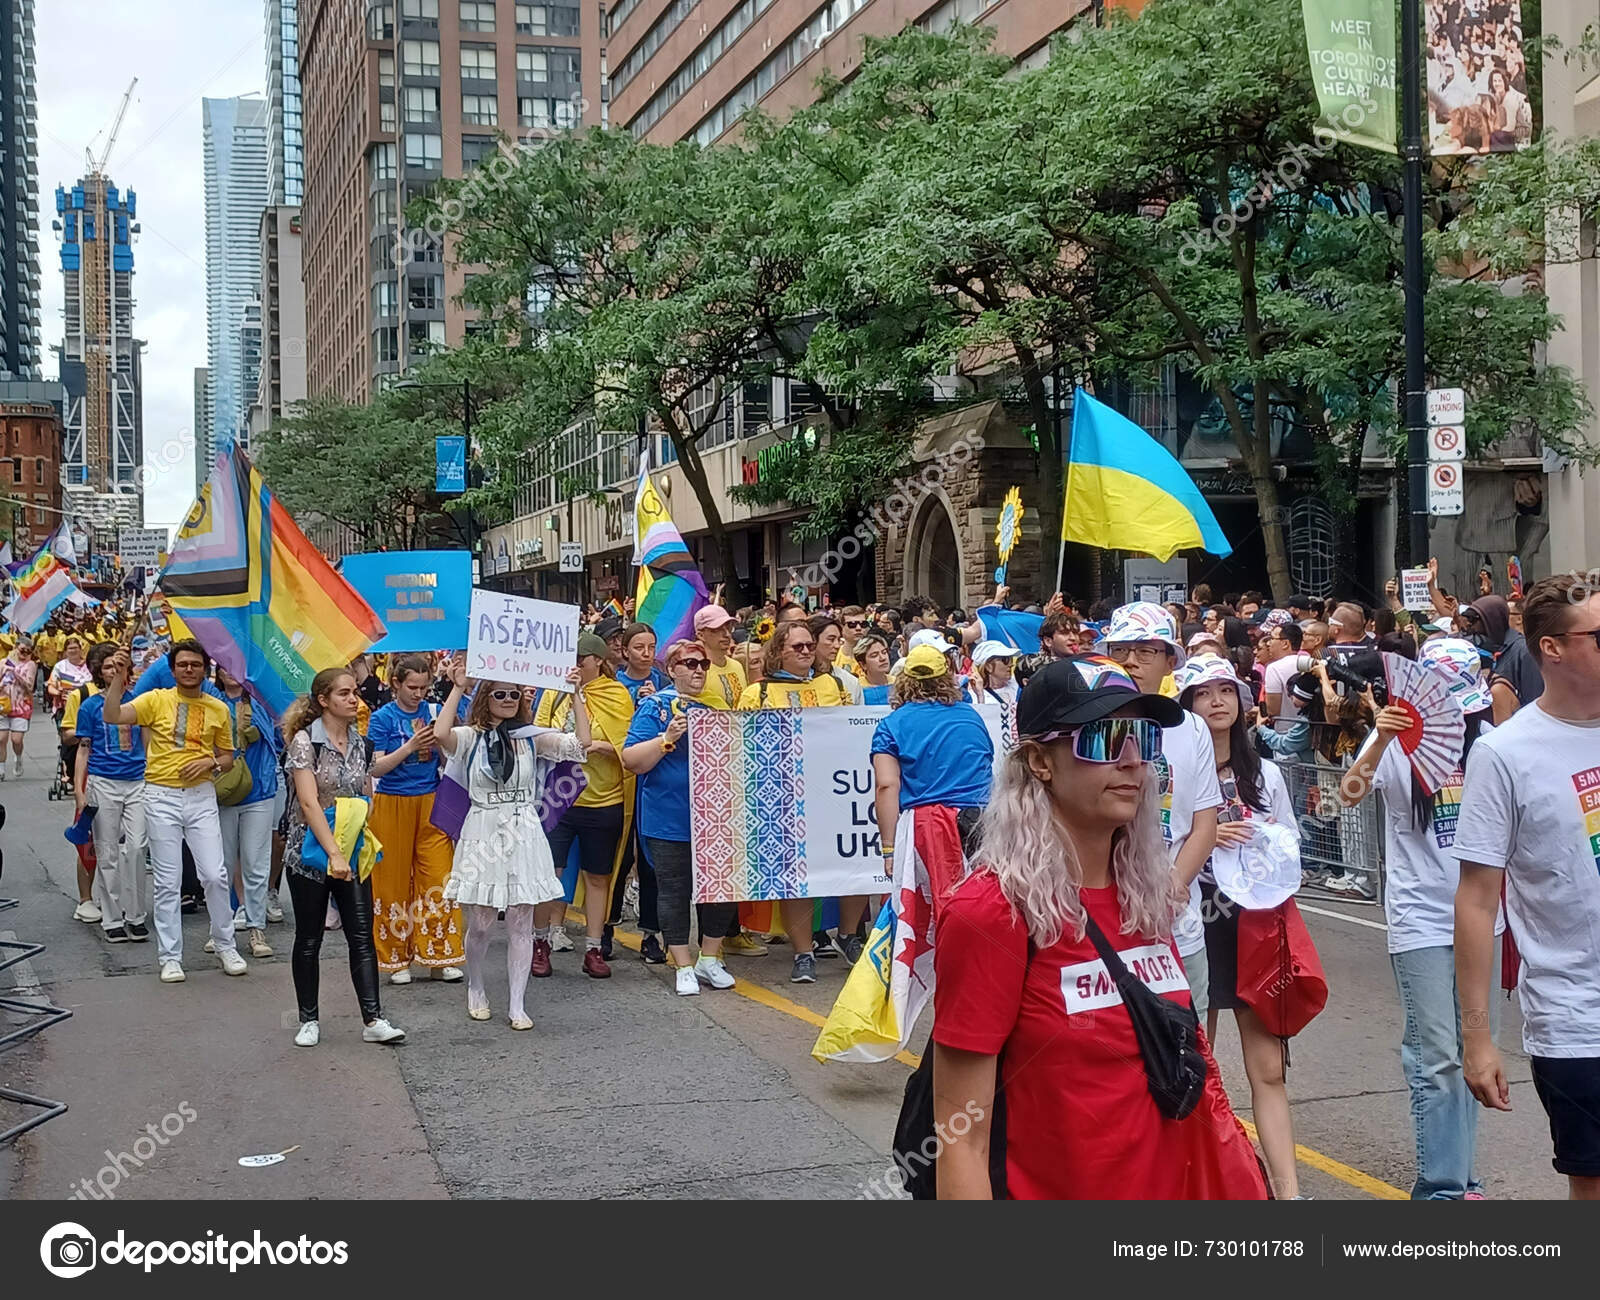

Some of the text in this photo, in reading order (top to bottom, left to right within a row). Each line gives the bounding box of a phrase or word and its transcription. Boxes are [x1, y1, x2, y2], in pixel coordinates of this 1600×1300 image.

[1330, 19, 1371, 35] MEET
[1358, 36, 1373, 51] IN
[1312, 50, 1396, 72] TORONTO'S
[1325, 66, 1395, 90] CULTURAL
[1322, 82, 1370, 99] HEART
[1440, 392, 1451, 401] NO
[1430, 402, 1463, 413] STANDING
[562, 554, 582, 567] 40
[479, 613, 575, 653] ASEXUAL
[477, 654, 497, 670] SO
[503, 658, 530, 673] CAN
